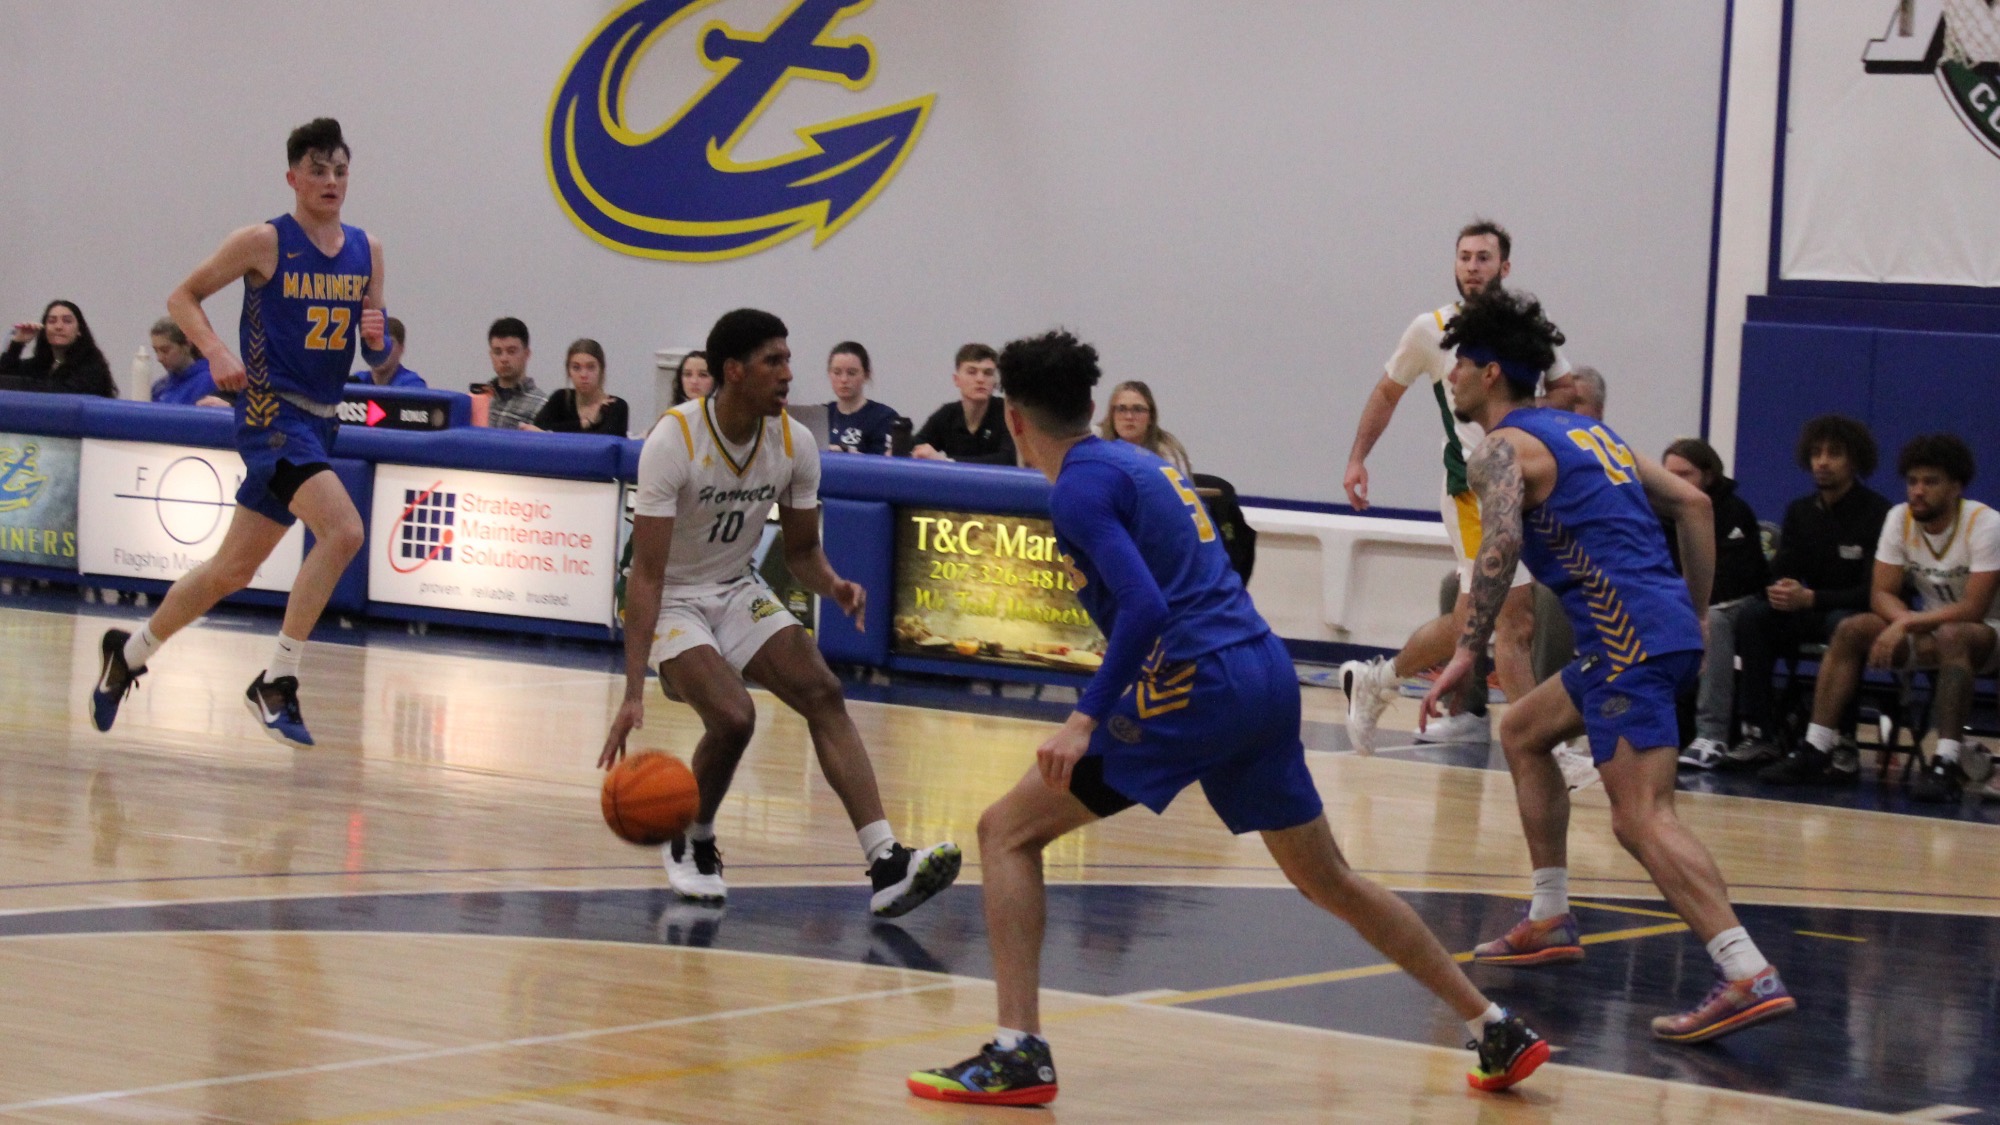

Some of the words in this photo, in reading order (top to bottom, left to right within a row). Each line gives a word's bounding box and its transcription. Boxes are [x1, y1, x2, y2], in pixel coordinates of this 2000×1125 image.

[304, 306, 351, 350] 22
[400, 409, 429, 423] BONUS
[461, 492, 552, 522] Strategic
[699, 485, 776, 504] Hornets
[1159, 466, 1216, 543] 5
[460, 519, 593, 549] Maintenance
[707, 510, 744, 543] 10
[911, 516, 984, 556] T&C
[995, 522, 1064, 563] Mar
[113, 547, 169, 573] Flagship
[460, 545, 558, 574] Solutions,
[563, 554, 595, 577] Inc.
[419, 581, 462, 597] proven.
[472, 584, 517, 602] reliable.
[526, 590, 570, 607] trusted.
